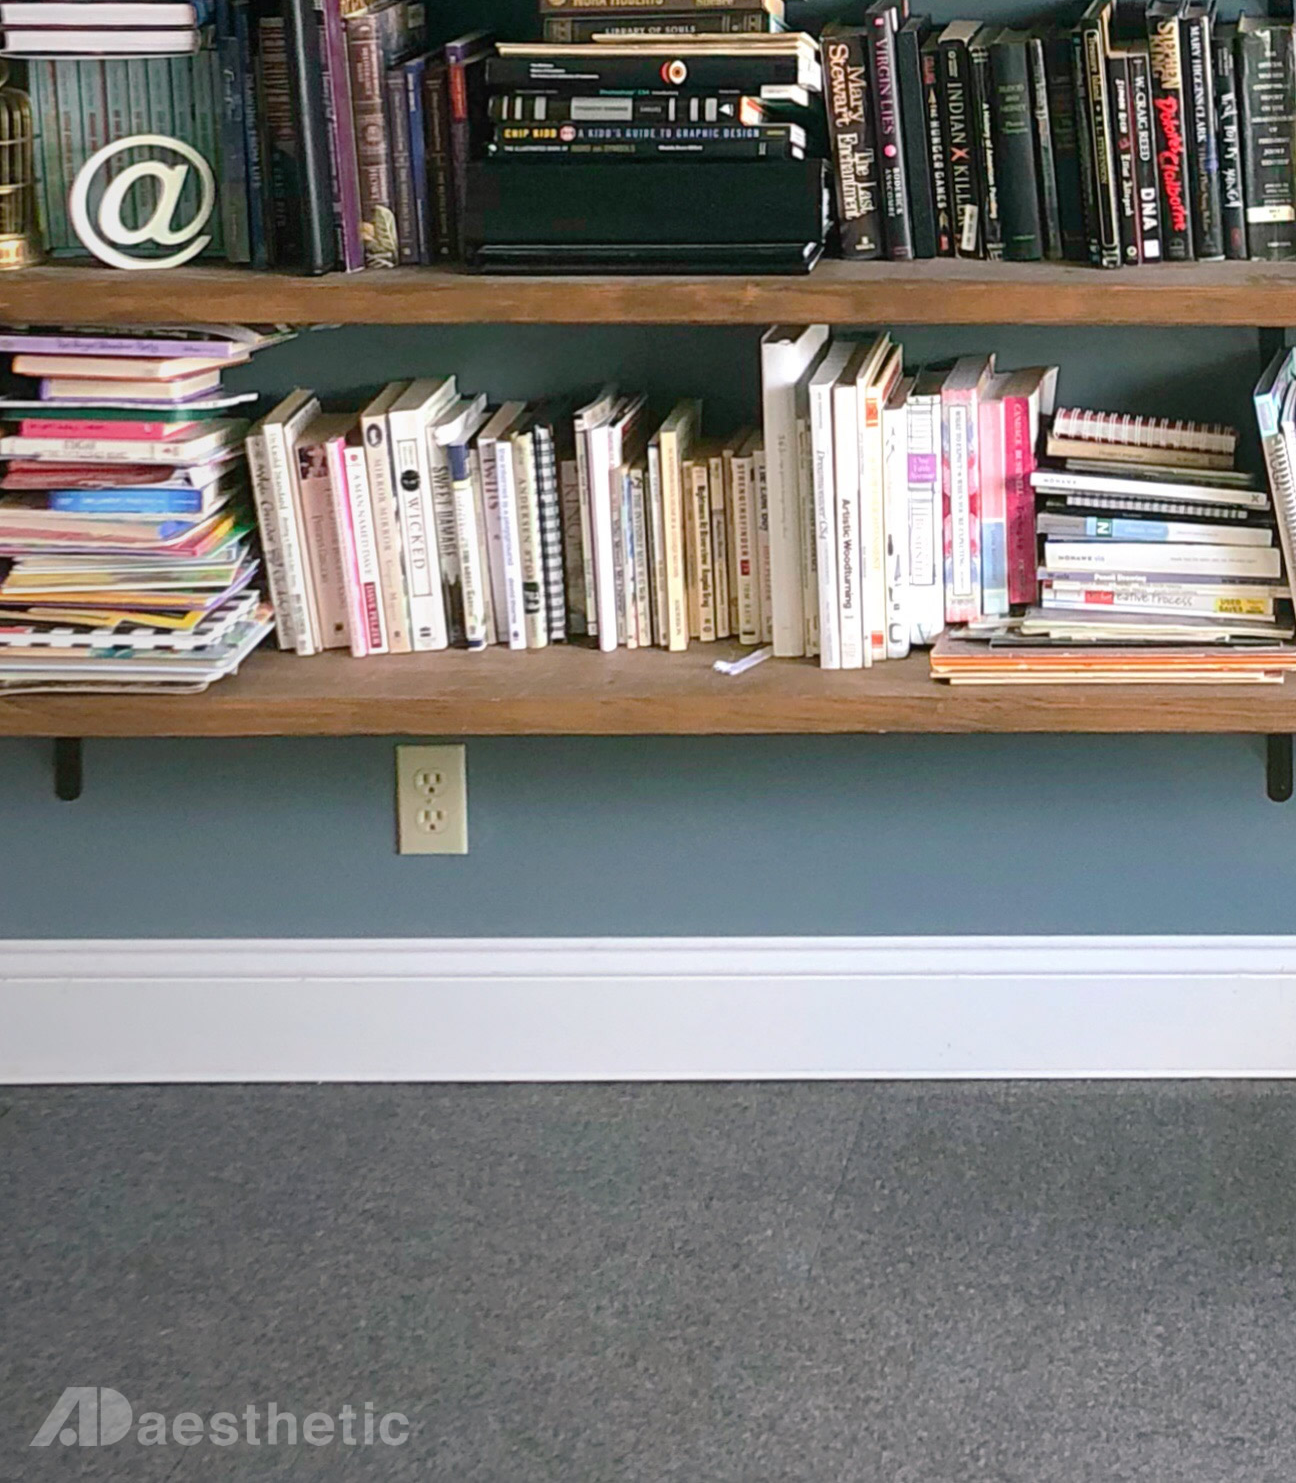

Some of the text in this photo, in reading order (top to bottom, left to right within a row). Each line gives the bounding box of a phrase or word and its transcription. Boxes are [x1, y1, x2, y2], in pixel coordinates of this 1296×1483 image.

[829, 43, 849, 127] Stewart
[846, 65, 866, 123] Mary
[875, 37, 895, 135] VIRGIN LIES
[1157, 21, 1179, 90] STEPHEN
[1189, 25, 1208, 143] MARY HIGGINS CLARK
[503, 128, 557, 139] CHIP KIDD
[578, 128, 760, 138] A KIDD'S GUIDE TO GRAPHIC DESIGN
[946, 82, 967, 143] INDIAN
[1133, 75, 1150, 161] W. CRAIG REED
[836, 133, 860, 219] Enchantment
[855, 147, 876, 215] The Last
[929, 104, 947, 209] THE HUNGER GAMES
[1154, 96, 1187, 232] Dolores Claiborne
[1140, 187, 1157, 231] DNA
[1012, 403, 1026, 497] CANDACE BUSHNELL
[352, 473, 373, 576] A MAN NAMED DAVE
[407, 496, 426, 571] WICKED
[432, 466, 456, 558] SWEET DAMAGE
[564, 483, 579, 540] KING
[737, 463, 749, 557] STRENGTHSFINDER
[841, 498, 854, 609] Artistic Woodturning
[365, 585, 381, 645] DAVE PELZER
